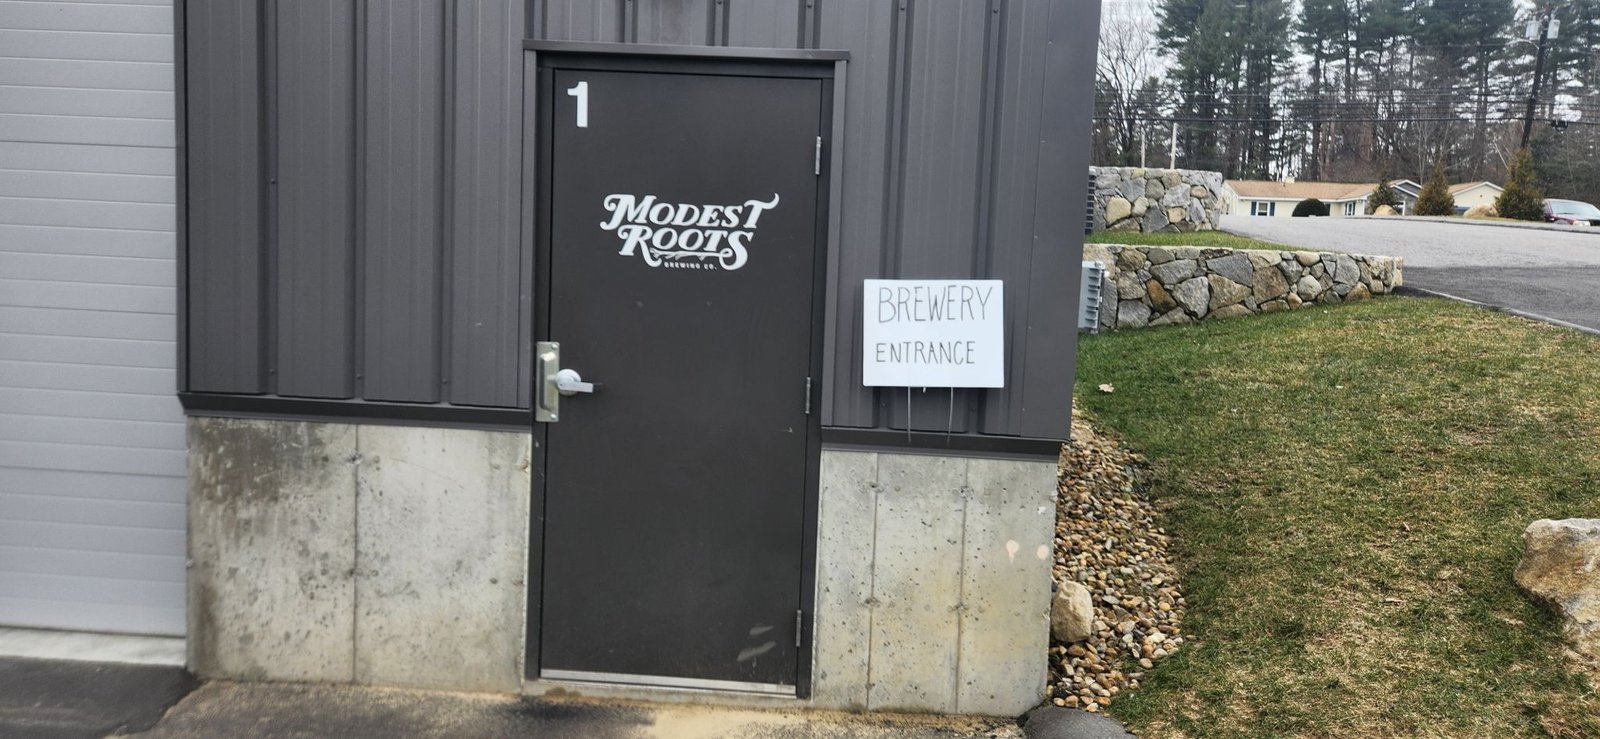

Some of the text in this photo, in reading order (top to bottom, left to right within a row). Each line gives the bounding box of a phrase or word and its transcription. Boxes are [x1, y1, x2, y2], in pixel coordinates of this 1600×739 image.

[567, 81, 588, 128] 1
[600, 192, 780, 230] MODEST
[617, 224, 754, 271] ROOTS
[664, 261, 701, 270] BREWING
[878, 285, 993, 323] BREWERY
[876, 341, 976, 365] ENTRANCE
